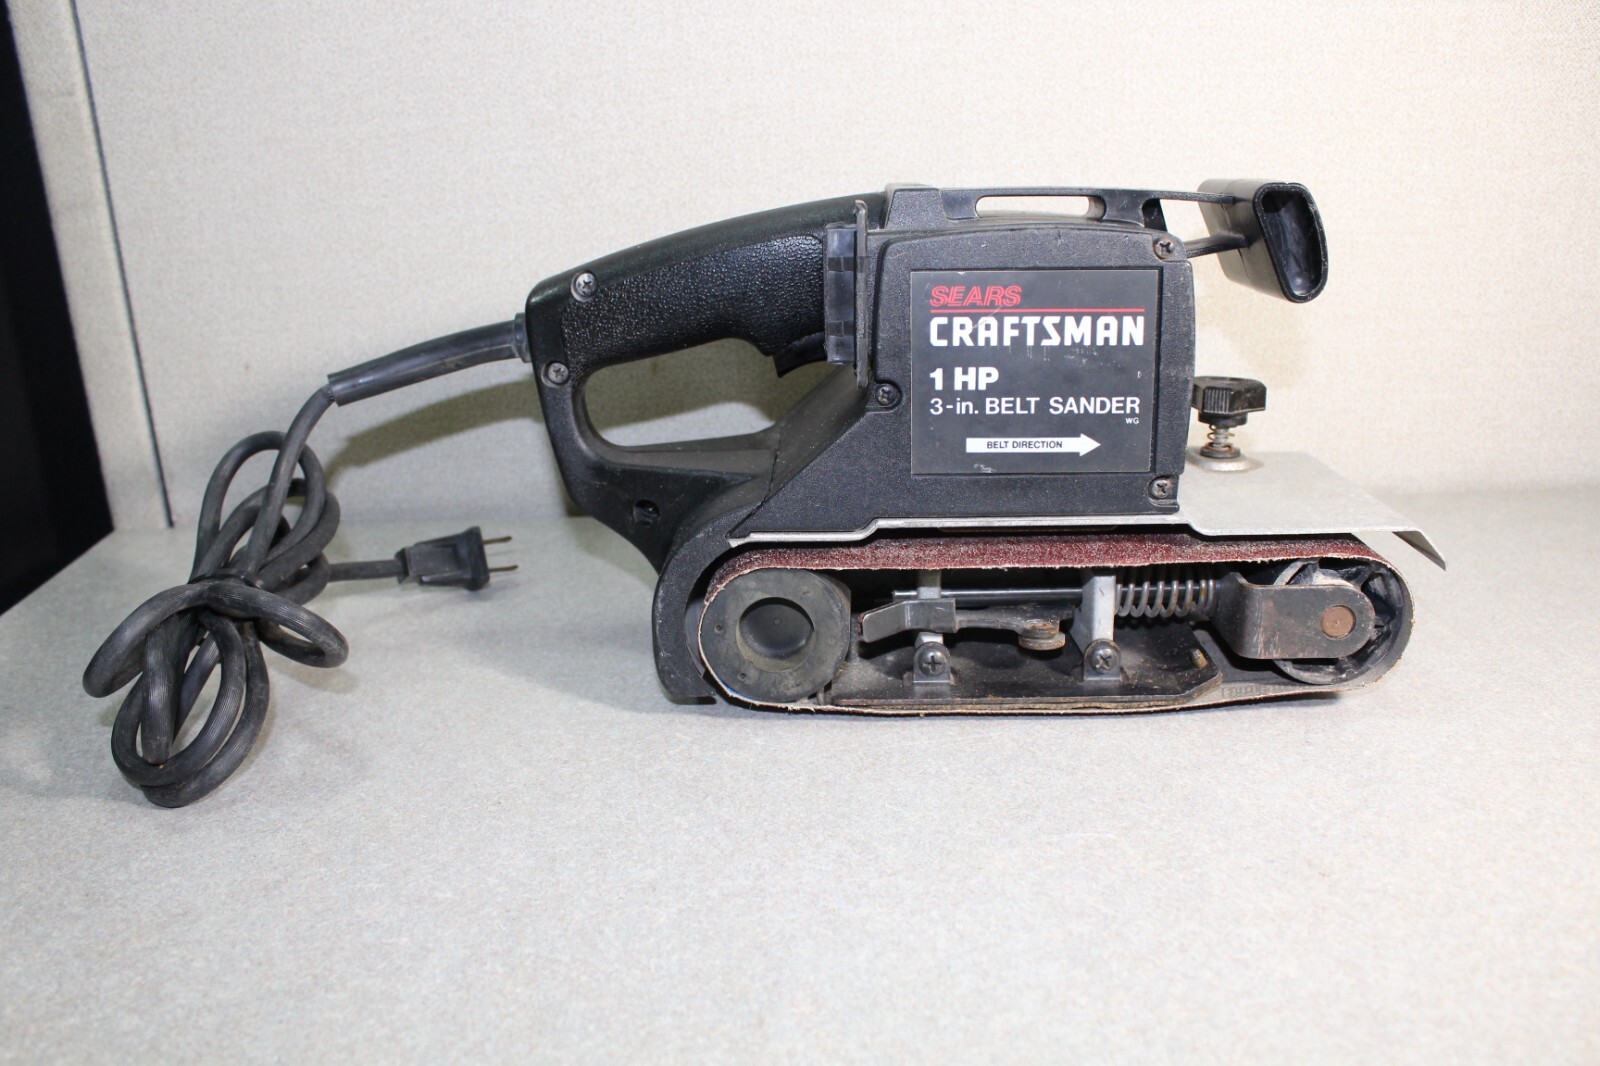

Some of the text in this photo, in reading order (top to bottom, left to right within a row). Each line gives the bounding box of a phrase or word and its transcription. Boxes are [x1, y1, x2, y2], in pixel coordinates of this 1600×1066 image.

[929, 285, 1022, 307] SEARS
[929, 315, 1145, 347] CRAFTSMAN
[929, 366, 999, 391] 1 HP
[985, 397, 1040, 415] BELT
[1049, 396, 1140, 415] SANDER
[1125, 417, 1140, 425] WG
[986, 440, 1063, 449] BELT DIRECTION
